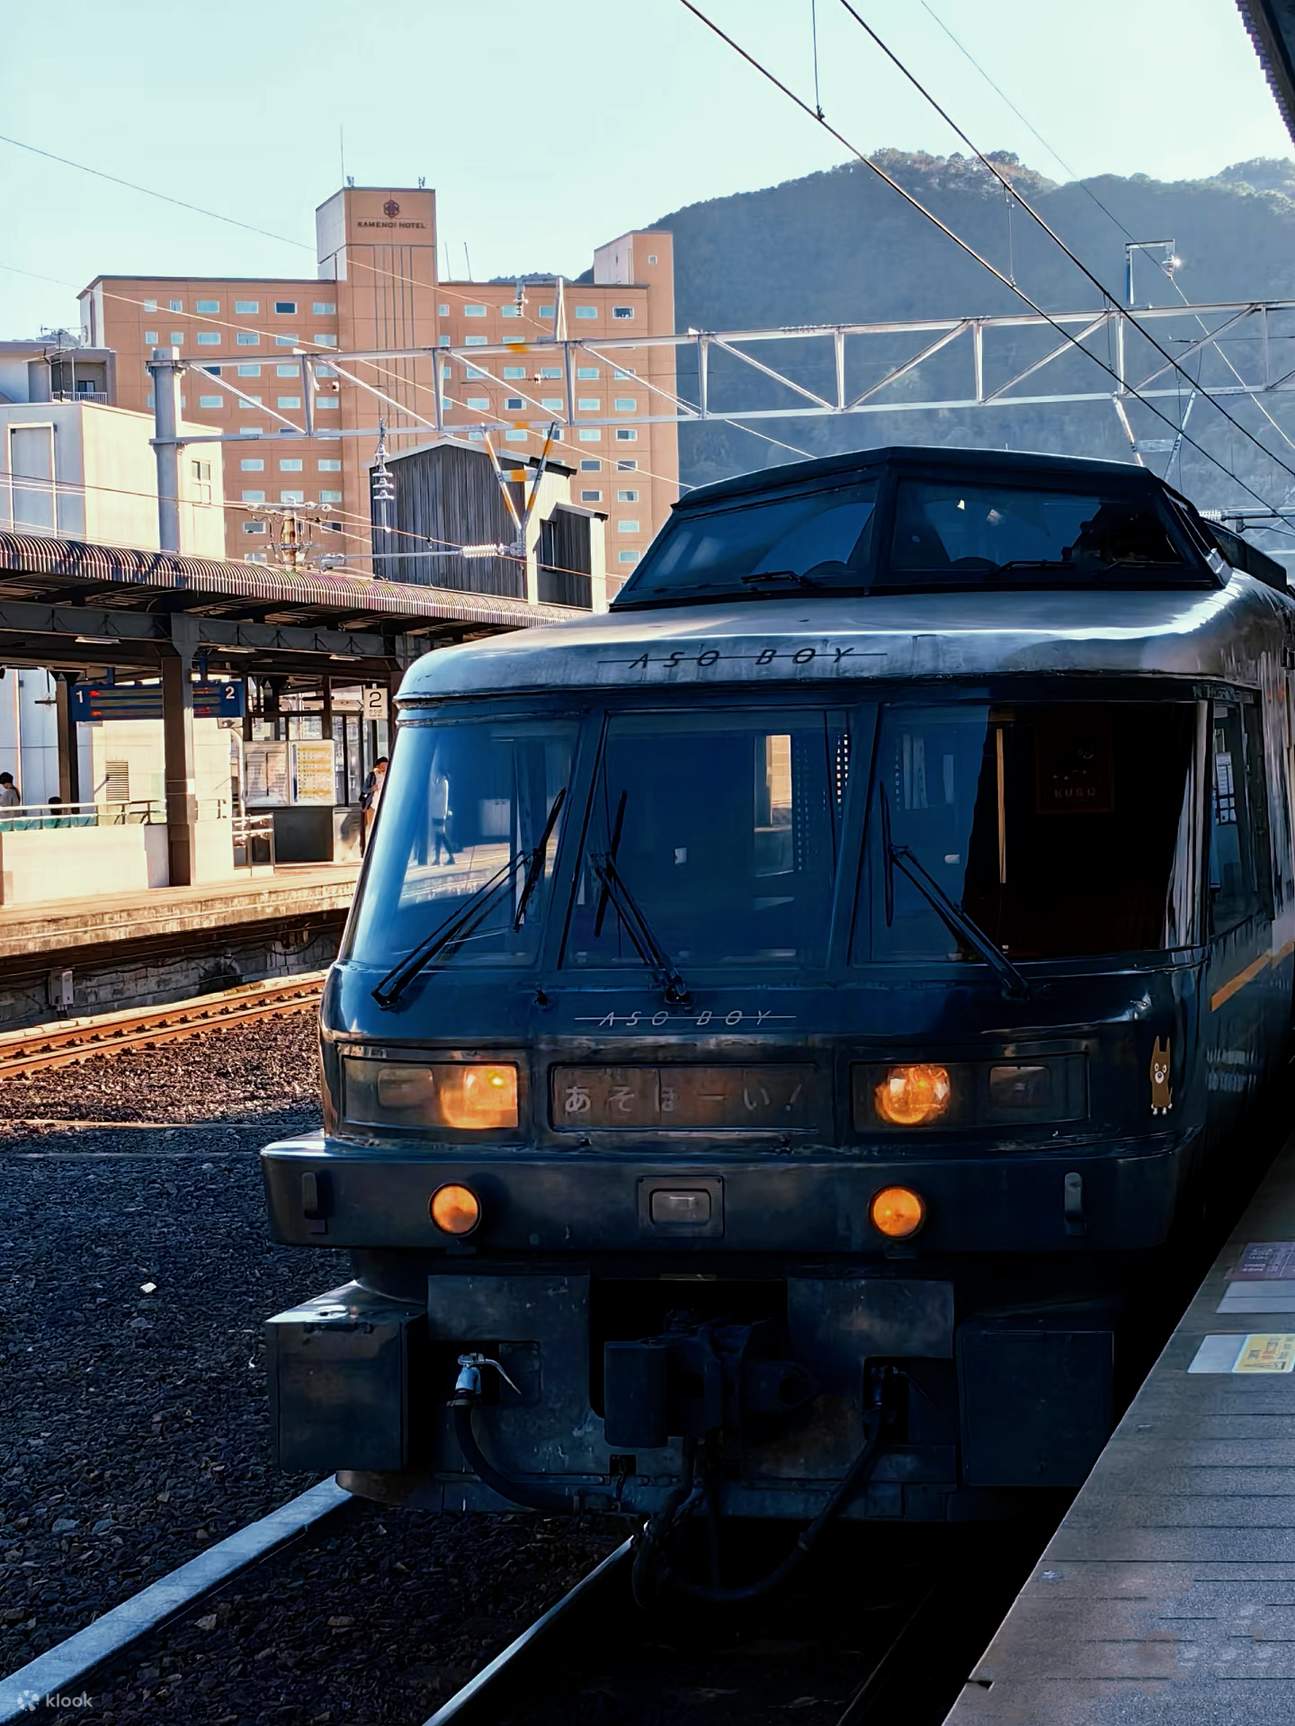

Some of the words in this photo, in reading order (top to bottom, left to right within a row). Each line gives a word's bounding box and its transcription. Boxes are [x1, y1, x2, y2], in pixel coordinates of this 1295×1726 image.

[628, 650, 720, 669] ASO
[755, 647, 854, 665] BOY
[76, 690, 84, 704] 1
[225, 686, 235, 699] 2
[369, 691, 382, 708] 2
[599, 1011, 669, 1026] ASO
[696, 1010, 772, 1025] BOY
